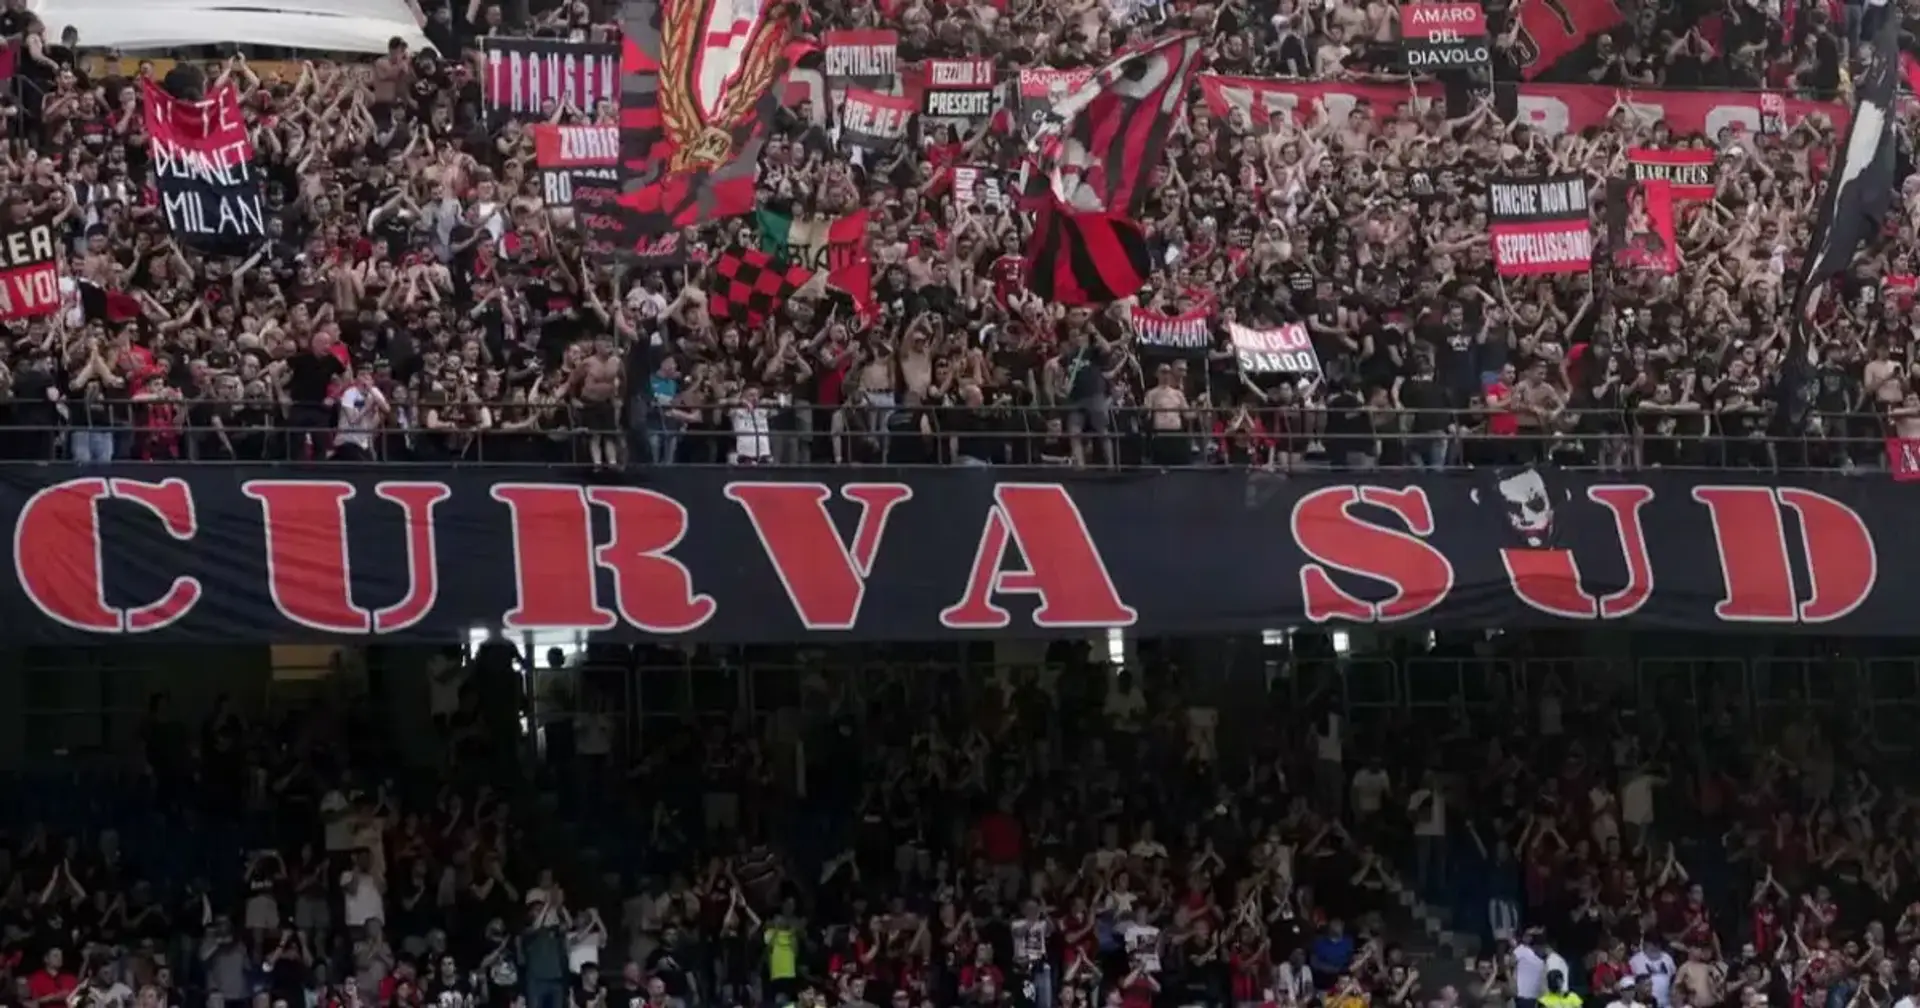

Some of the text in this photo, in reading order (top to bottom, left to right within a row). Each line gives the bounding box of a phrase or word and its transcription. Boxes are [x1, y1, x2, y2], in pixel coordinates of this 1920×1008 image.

[1412, 8, 1476, 24] AMARO
[1429, 30, 1465, 44] DEL
[1408, 47, 1489, 66] DIAVOLO
[928, 91, 990, 115] PRESENTE
[1539, 181, 1569, 213] NON
[1569, 179, 1588, 211] MI
[163, 190, 265, 235] MILAN
[1239, 351, 1314, 374] SARDO
[13, 477, 1877, 633] CURVA SUD
